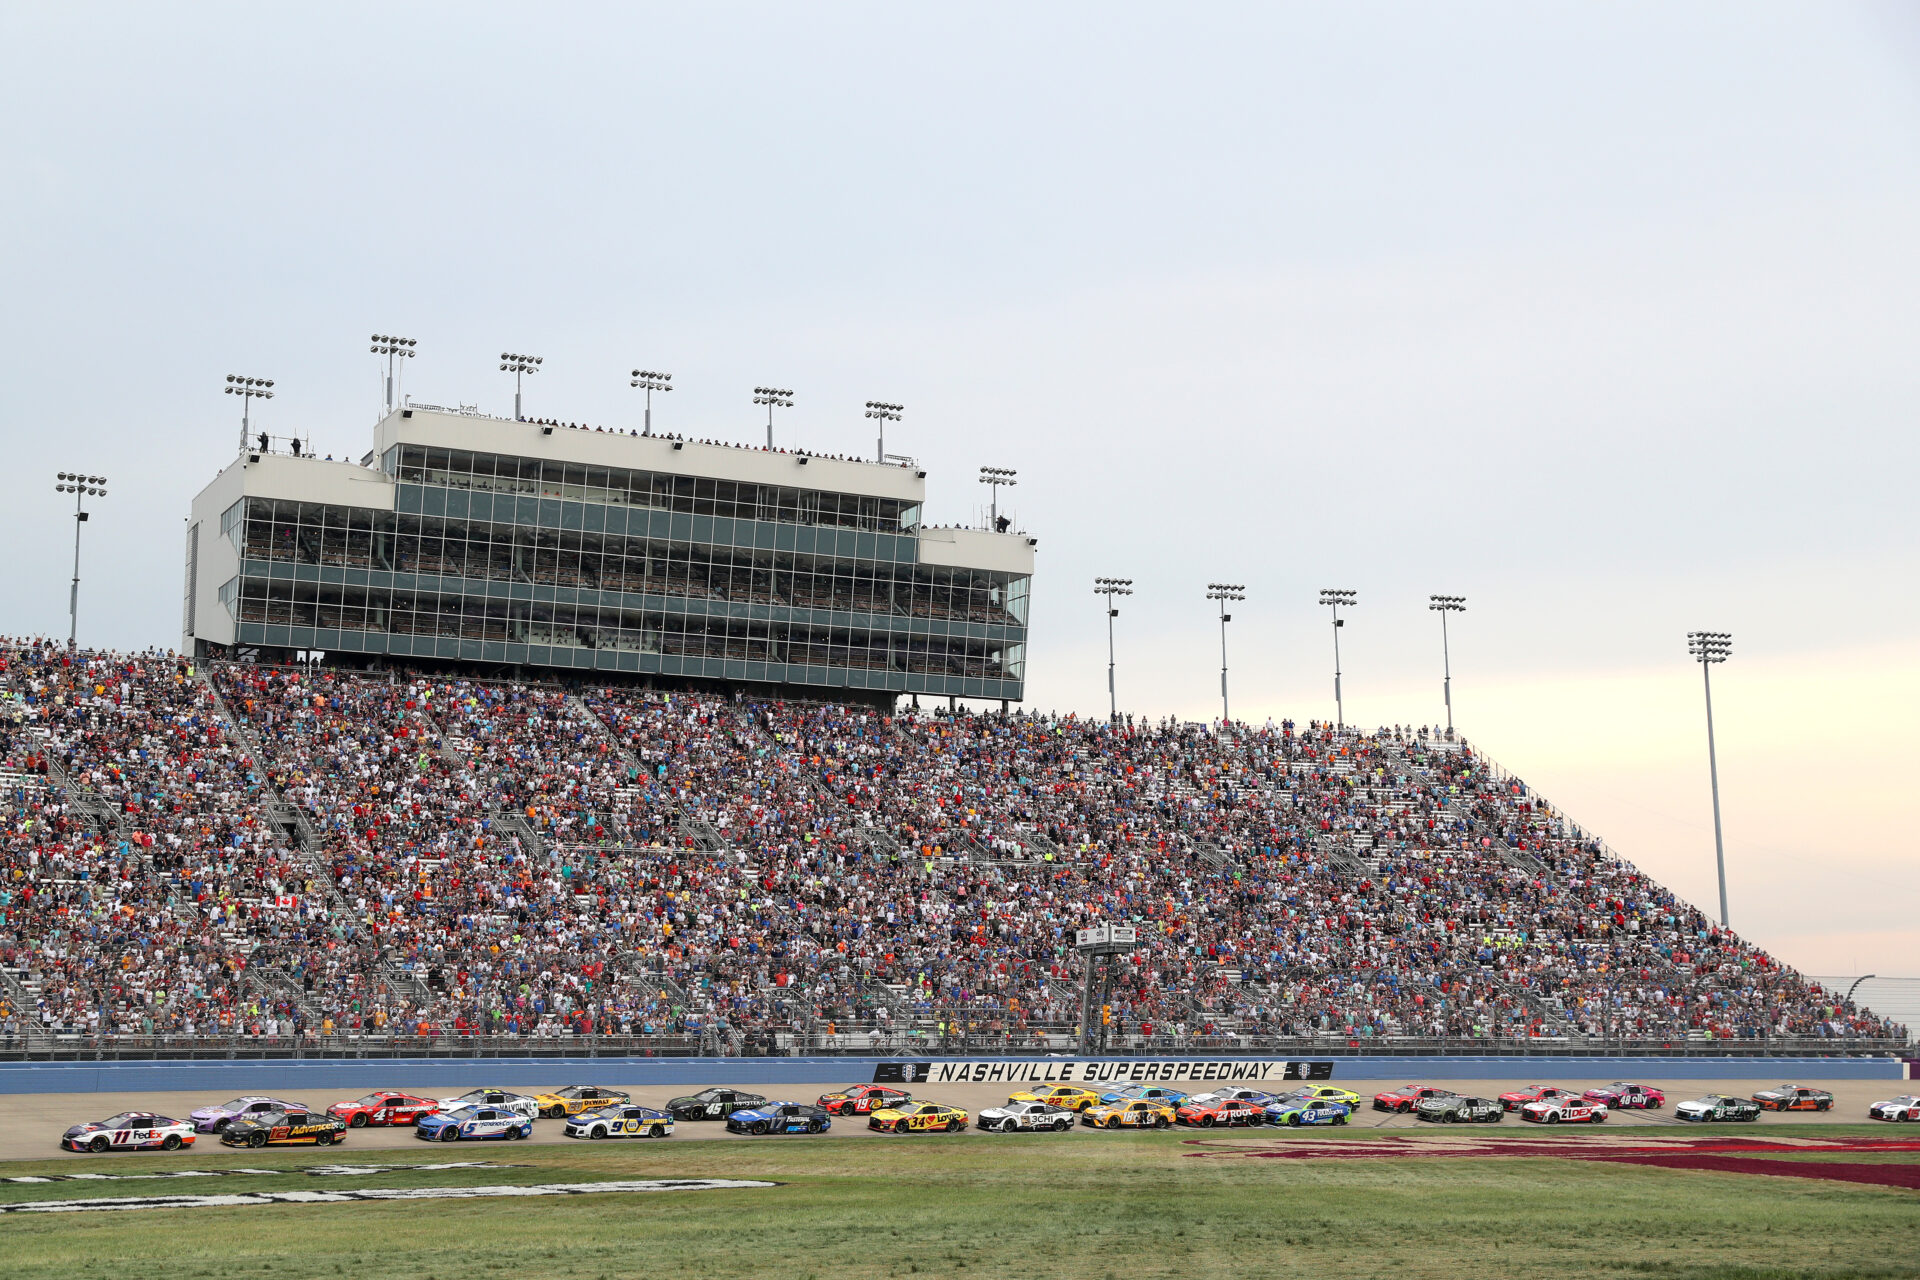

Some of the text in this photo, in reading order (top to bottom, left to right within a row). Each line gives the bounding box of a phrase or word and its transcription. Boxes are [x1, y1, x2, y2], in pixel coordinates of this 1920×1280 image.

[938, 1062, 1274, 1081] NASHVILLE SUPERSPEEDWAY
[856, 1099, 869, 1109] 19
[1048, 1097, 1062, 1105] 22
[1620, 1093, 1647, 1104] 48 ally
[1789, 1097, 1797, 1106] 7
[705, 1103, 723, 1115] 45
[1457, 1108, 1471, 1118] 42
[1561, 1108, 1593, 1119] 21 DEX
[1714, 1108, 1725, 1119] 31
[373, 1109, 387, 1121] 4
[1032, 1115, 1053, 1123] 3CHI
[1122, 1112, 1132, 1122] 18
[1216, 1109, 1253, 1121] 23 ROOT
[1302, 1110, 1316, 1121] 43
[611, 1120, 623, 1132] 9
[769, 1117, 786, 1129] 17
[910, 1117, 926, 1127] 34
[269, 1123, 333, 1139] 12 Advance
[464, 1123, 477, 1134] 5
[113, 1130, 163, 1144] 11 FedEx
